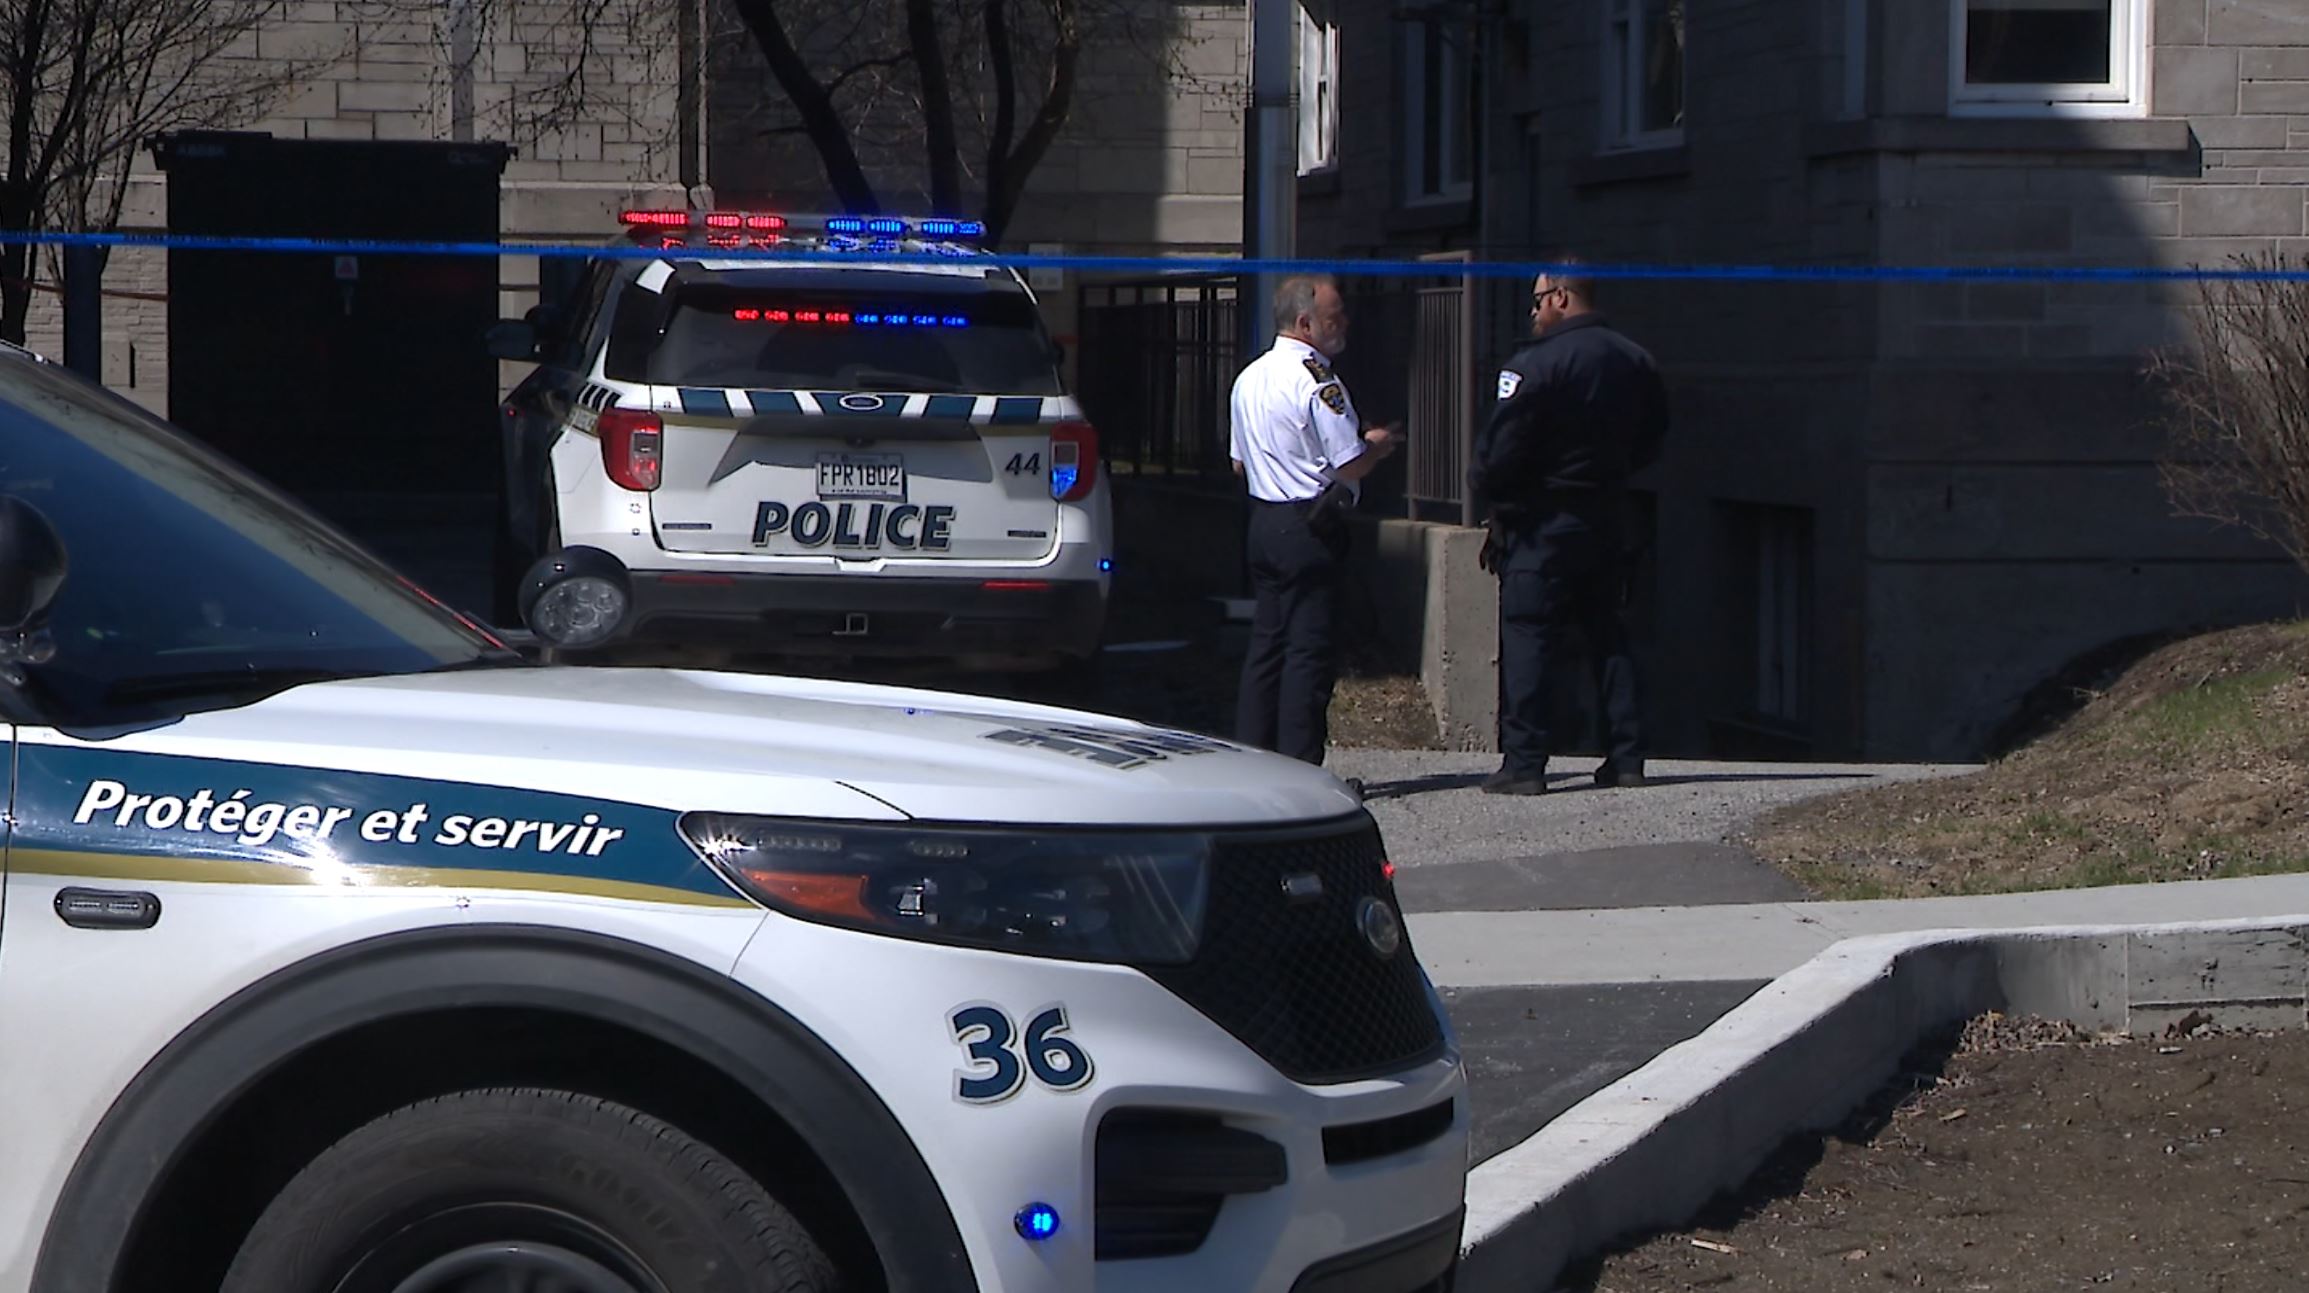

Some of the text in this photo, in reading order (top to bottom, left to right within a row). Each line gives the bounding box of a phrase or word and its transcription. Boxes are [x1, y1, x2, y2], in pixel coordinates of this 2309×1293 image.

[820, 462, 900, 487] FPR1802
[1005, 453, 1041, 475] 44
[752, 501, 955, 550] POLICE
[72, 779, 625, 857] Protéger et servir
[947, 1000, 1095, 1105] 36
